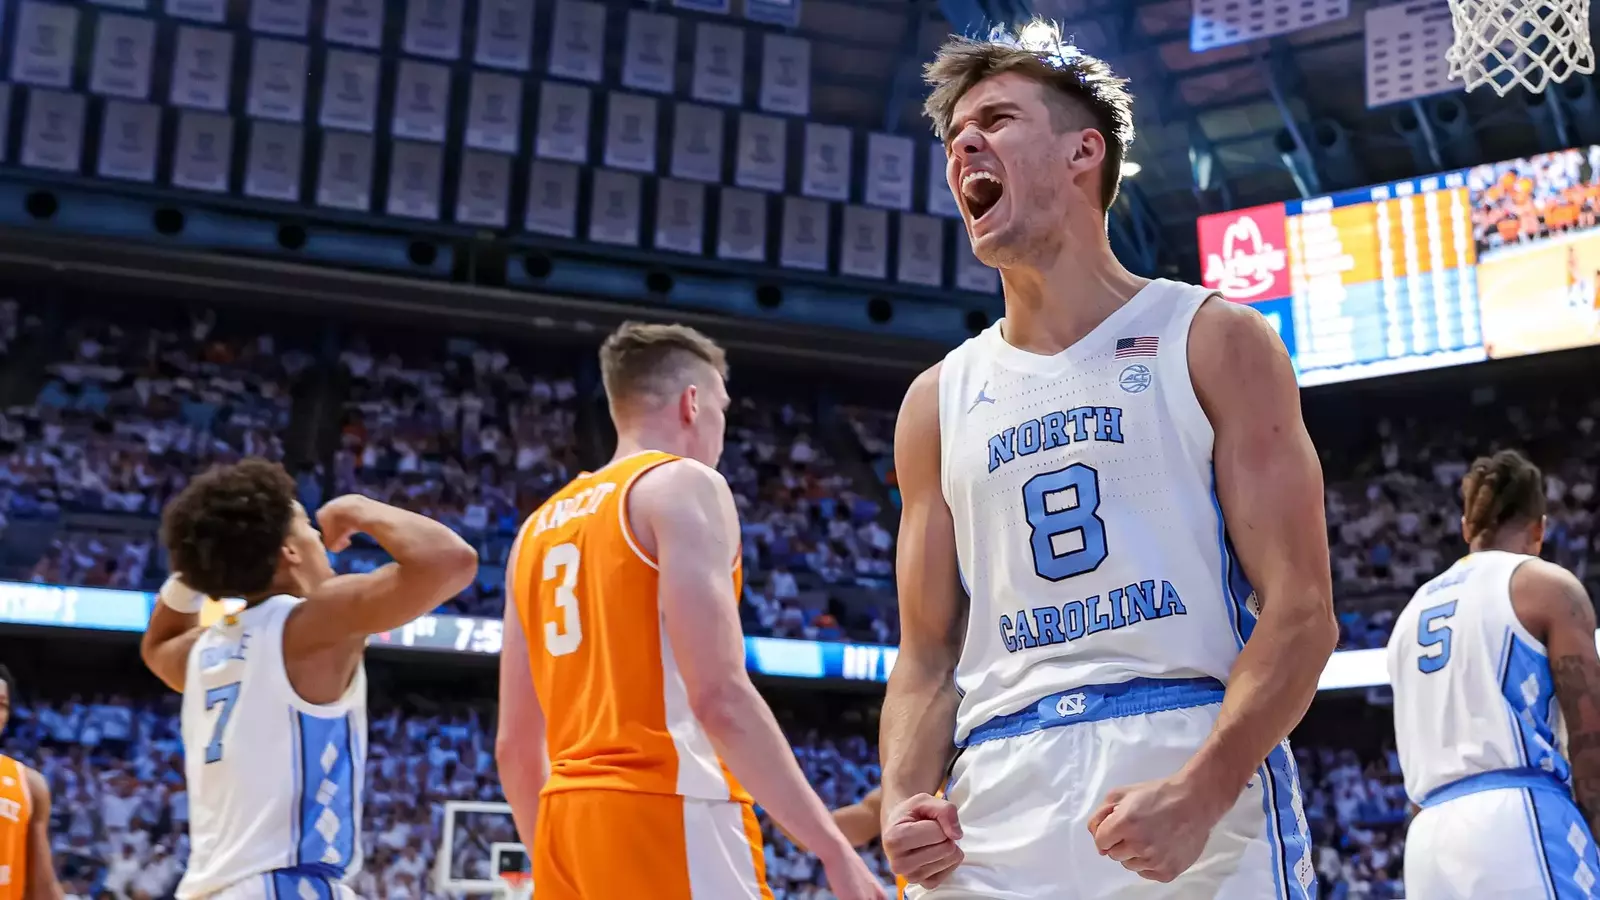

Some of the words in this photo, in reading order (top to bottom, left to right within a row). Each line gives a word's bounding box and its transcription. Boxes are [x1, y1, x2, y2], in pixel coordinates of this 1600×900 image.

[988, 406, 1124, 473] NORTH
[1022, 462, 1108, 582] 8
[543, 542, 582, 657] 3
[999, 579, 1187, 653] CAROLINA
[1417, 599, 1458, 674] 5
[205, 681, 241, 764] 7
